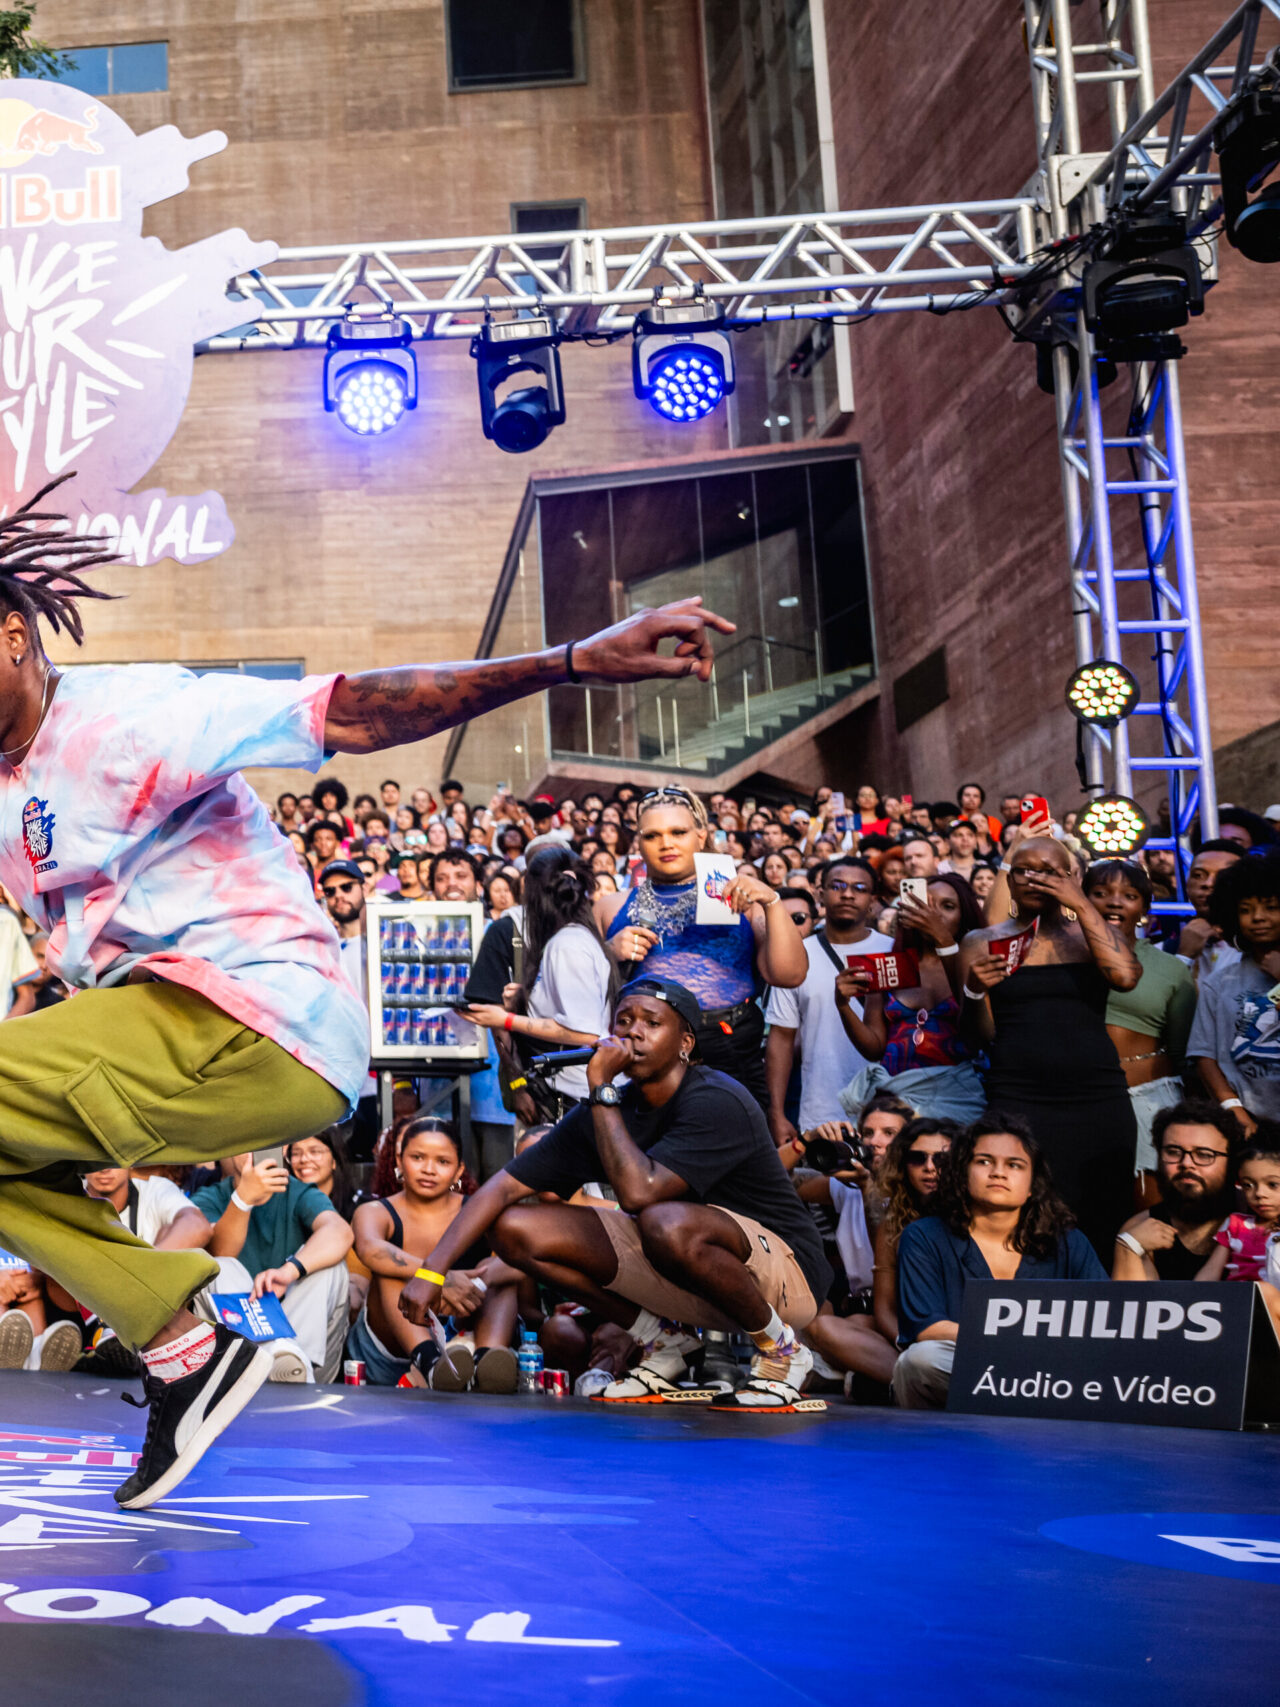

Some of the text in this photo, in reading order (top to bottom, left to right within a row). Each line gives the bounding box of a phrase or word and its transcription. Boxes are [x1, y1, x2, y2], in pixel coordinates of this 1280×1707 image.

[14, 166, 121, 228] Bull
[884, 956, 899, 988] RED
[983, 1298, 1223, 1342] PHILIPS
[971, 1365, 1216, 1406] Áudio e Vídeo
